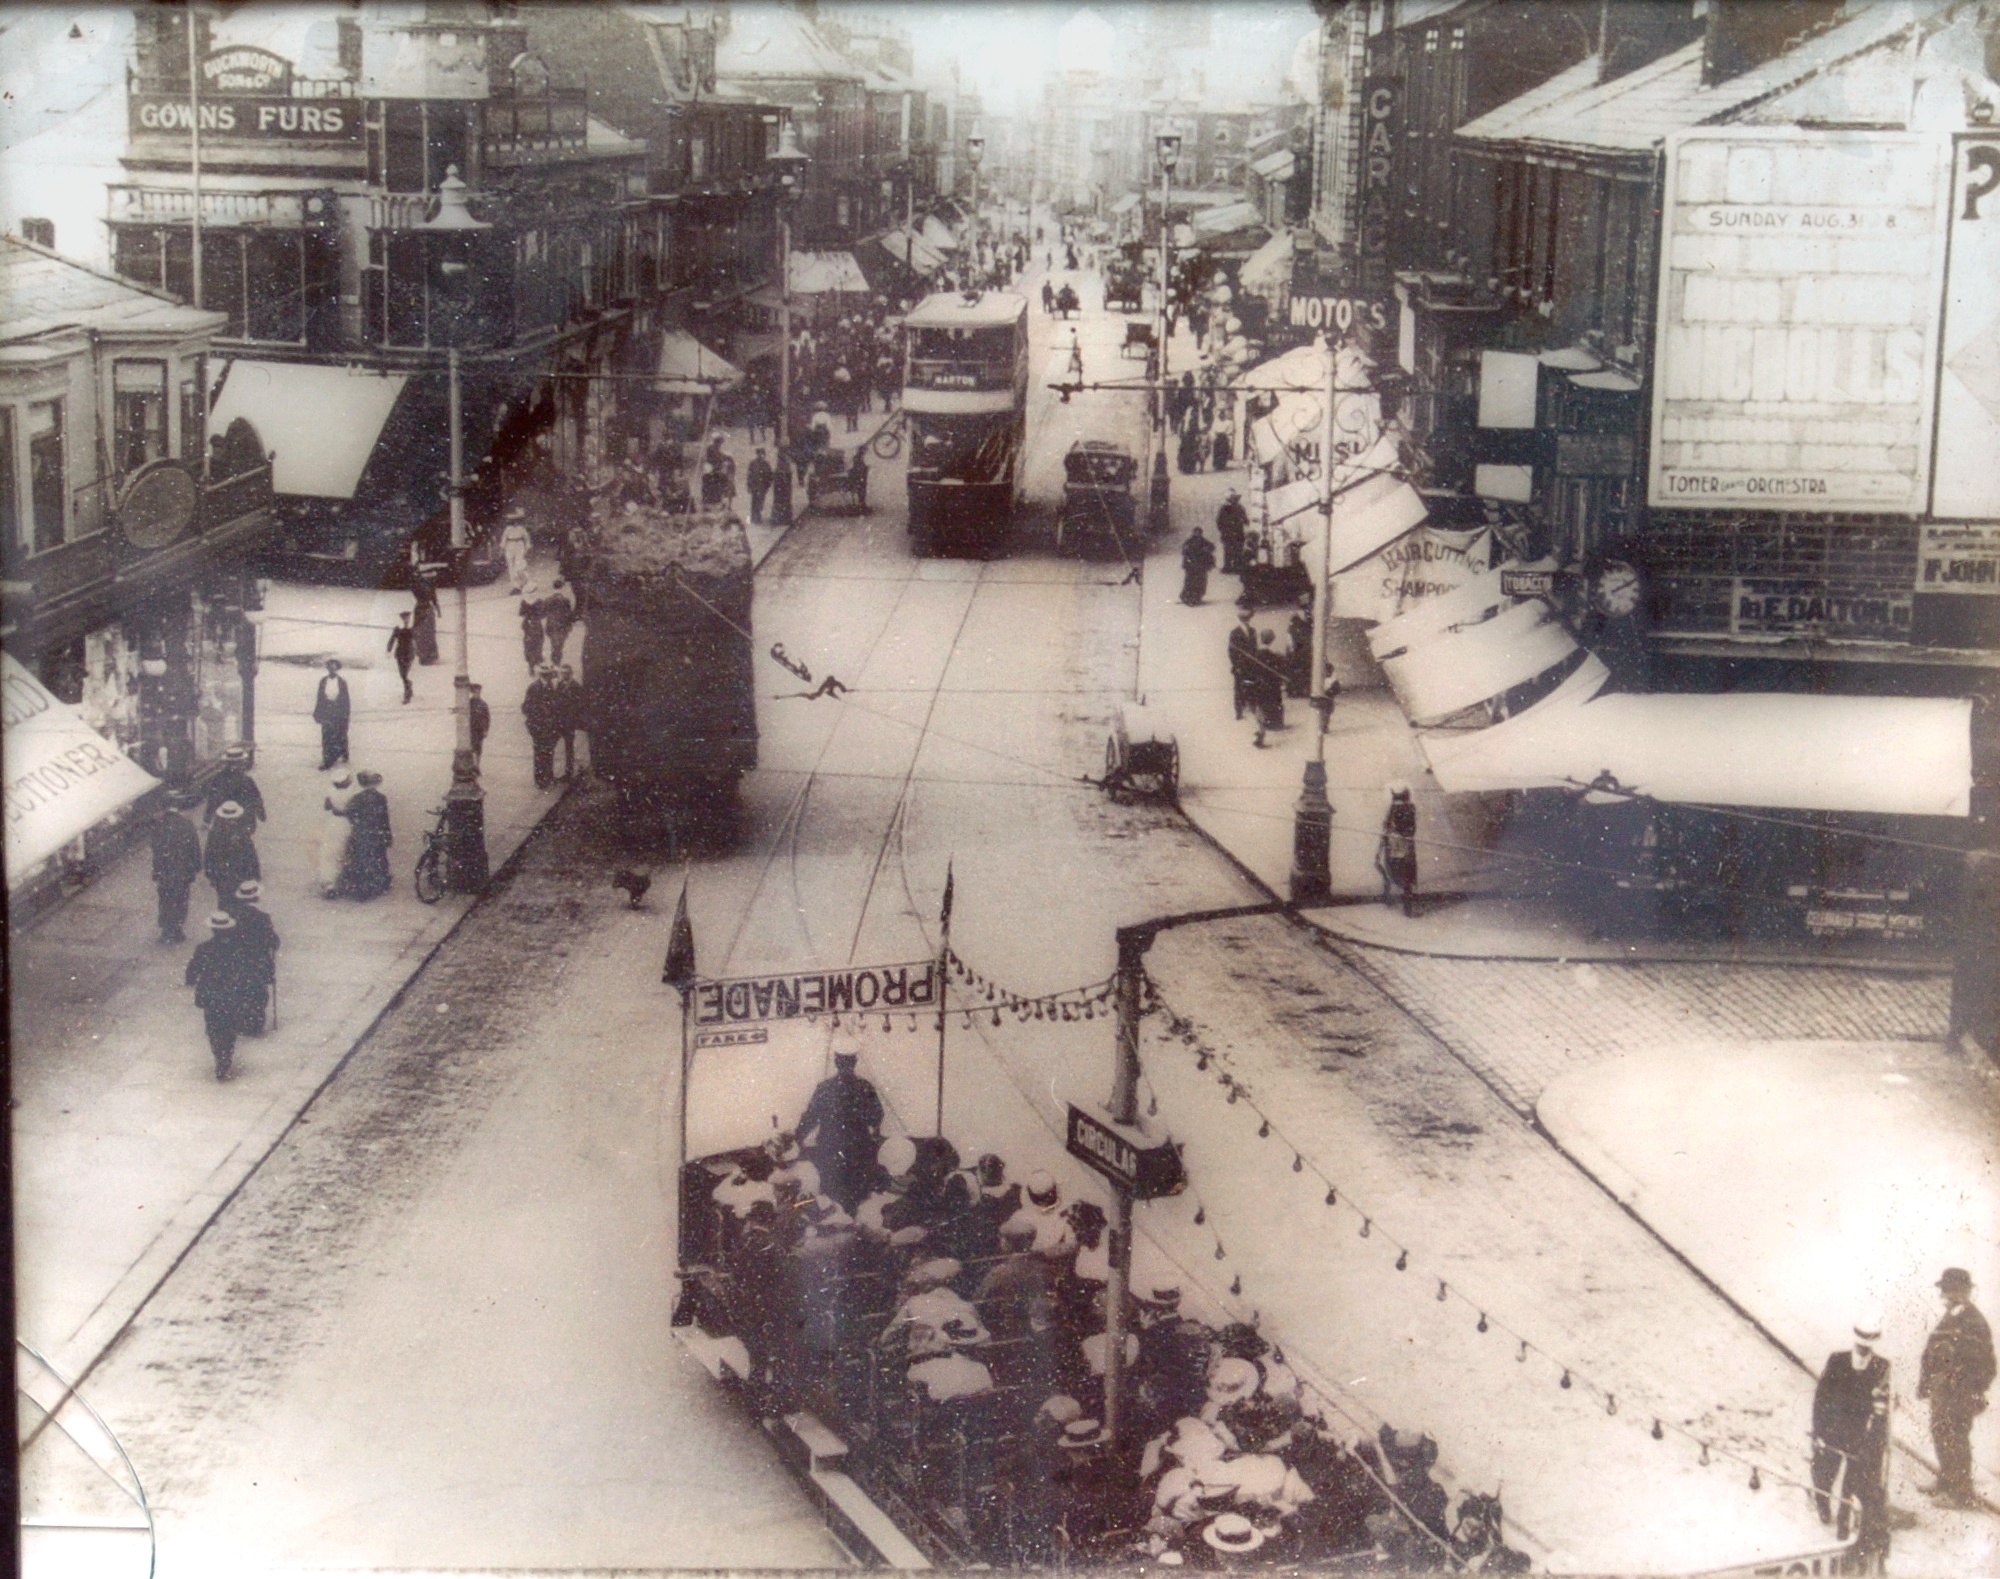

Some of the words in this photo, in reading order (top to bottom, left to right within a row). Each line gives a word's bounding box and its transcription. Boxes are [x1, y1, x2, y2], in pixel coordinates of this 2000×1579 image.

[140, 102, 237, 129] GOWNS
[258, 105, 344, 132] FURS
[1709, 210, 1788, 227] SUNDAY
[699, 965, 934, 1023] PROMENADE
